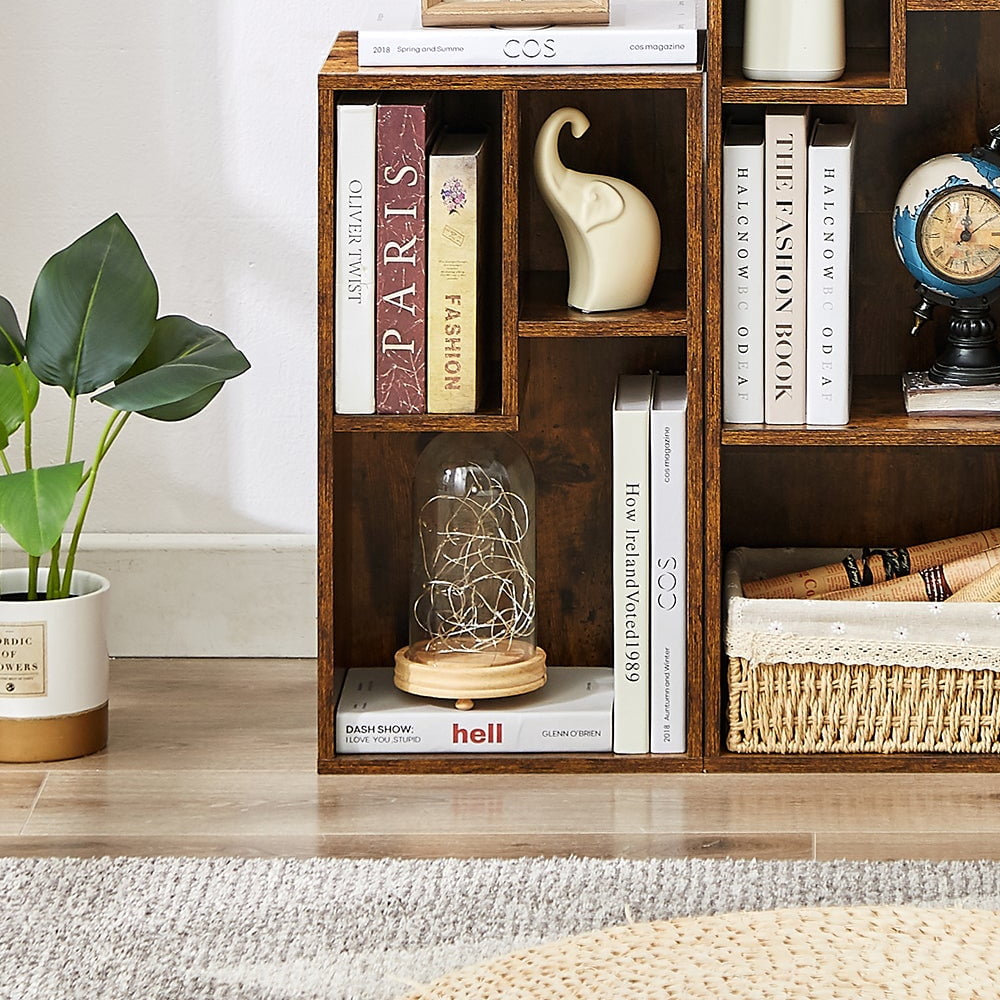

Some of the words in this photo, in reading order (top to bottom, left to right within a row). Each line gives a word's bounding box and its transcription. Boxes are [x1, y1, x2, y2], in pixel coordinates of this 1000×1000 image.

[397, 46, 420, 54] Spring
[503, 39, 557, 58] COS
[645, 43, 685, 51] magazine
[776, 133, 794, 191] THE
[348, 179, 363, 247] OLIVER
[381, 164, 420, 354] PARIS
[775, 201, 793, 313] FASHION
[347, 248, 362, 304] TWIST
[444, 294, 462, 391] FASHION
[775, 324, 793, 401] BOOK
[662, 426, 671, 467] magazine
[663, 468, 671, 483] cos
[625, 482, 640, 522] How
[657, 556, 677, 611] COS
[0, 637, 32, 646] RDIC
[2, 650, 17, 658] OF
[663, 647, 671, 672] Winter
[346, 725, 375, 734] DASH
[377, 725, 414, 734] SHOW:
[452, 723, 503, 744] hell
[570, 730, 602, 738] O'BRIEN
[663, 725, 671, 742] 2018
